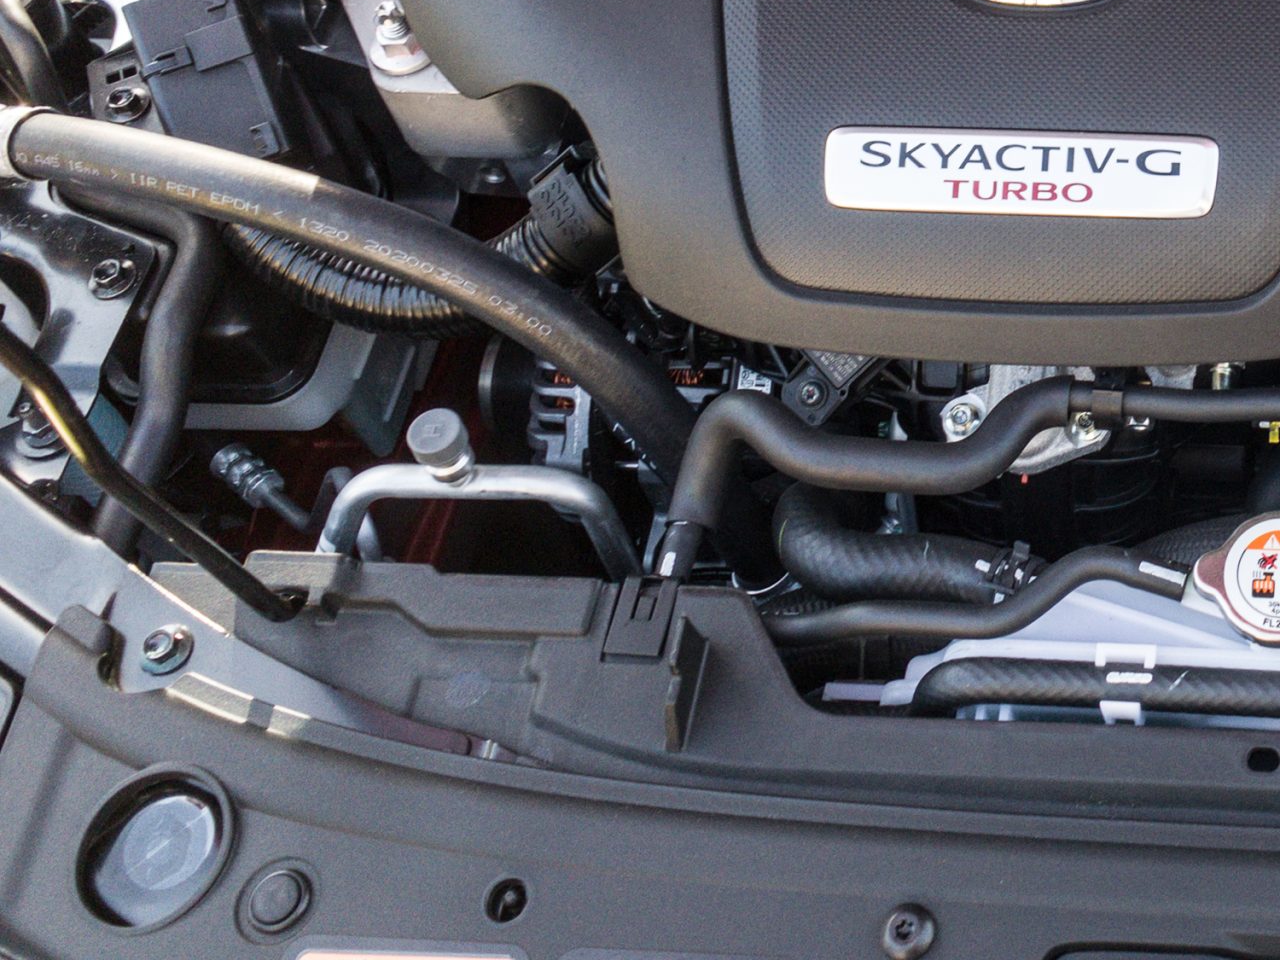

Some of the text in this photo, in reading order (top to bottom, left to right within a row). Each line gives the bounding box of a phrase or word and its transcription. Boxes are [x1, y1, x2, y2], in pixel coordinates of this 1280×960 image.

[859, 140, 1182, 176] SKYACTIV-G
[165, 180, 201, 200] PET
[210, 191, 261, 215] EPDM
[943, 179, 1093, 203] TURBO
